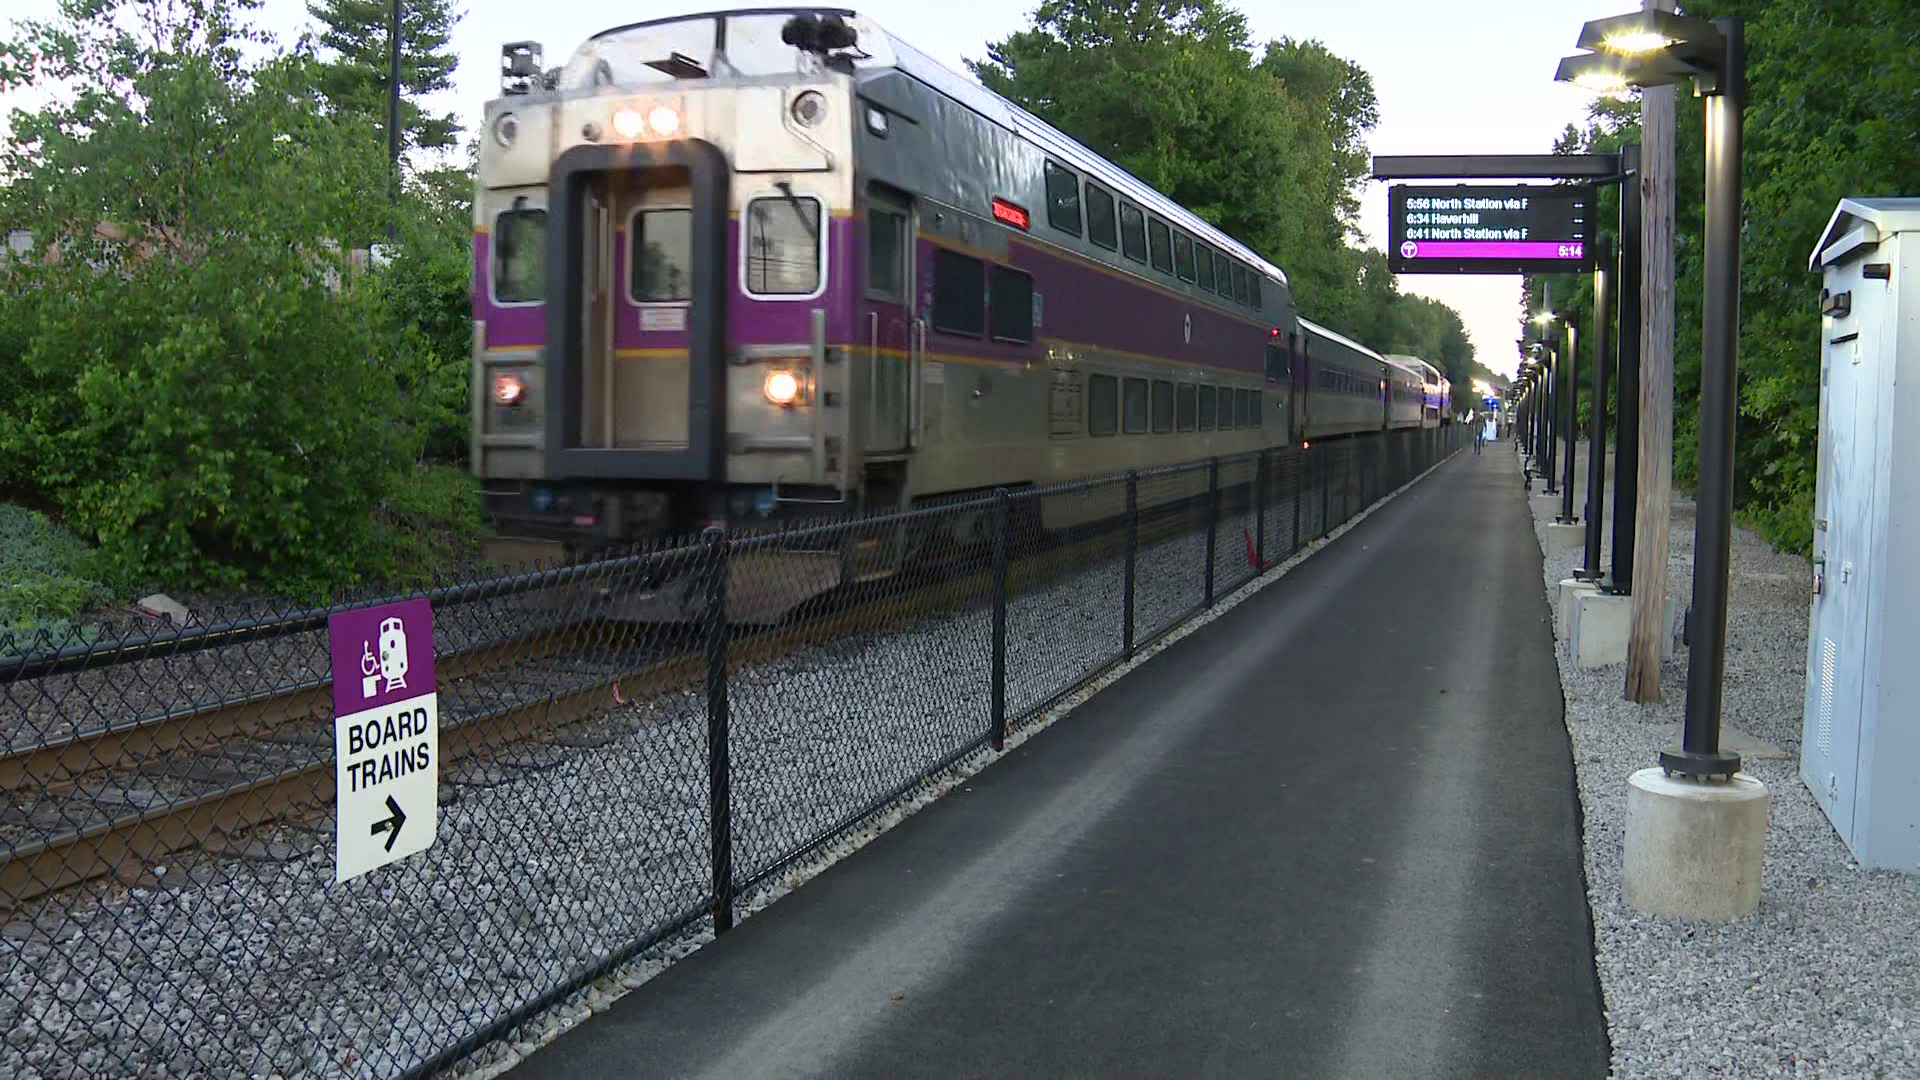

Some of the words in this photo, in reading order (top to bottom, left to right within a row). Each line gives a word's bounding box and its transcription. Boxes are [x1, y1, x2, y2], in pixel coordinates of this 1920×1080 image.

[1431, 198, 1461, 209] North
[1463, 198, 1502, 209] Station
[1503, 198, 1520, 209] via
[1406, 213, 1430, 224] 6:34
[1431, 213, 1479, 224] Haverhill
[1406, 228, 1429, 239] 6:41
[1431, 228, 1461, 239] North
[1463, 228, 1502, 239] Station
[1503, 228, 1520, 239] via
[349, 707, 427, 755] BOARD
[346, 742, 429, 792] TRAINS
